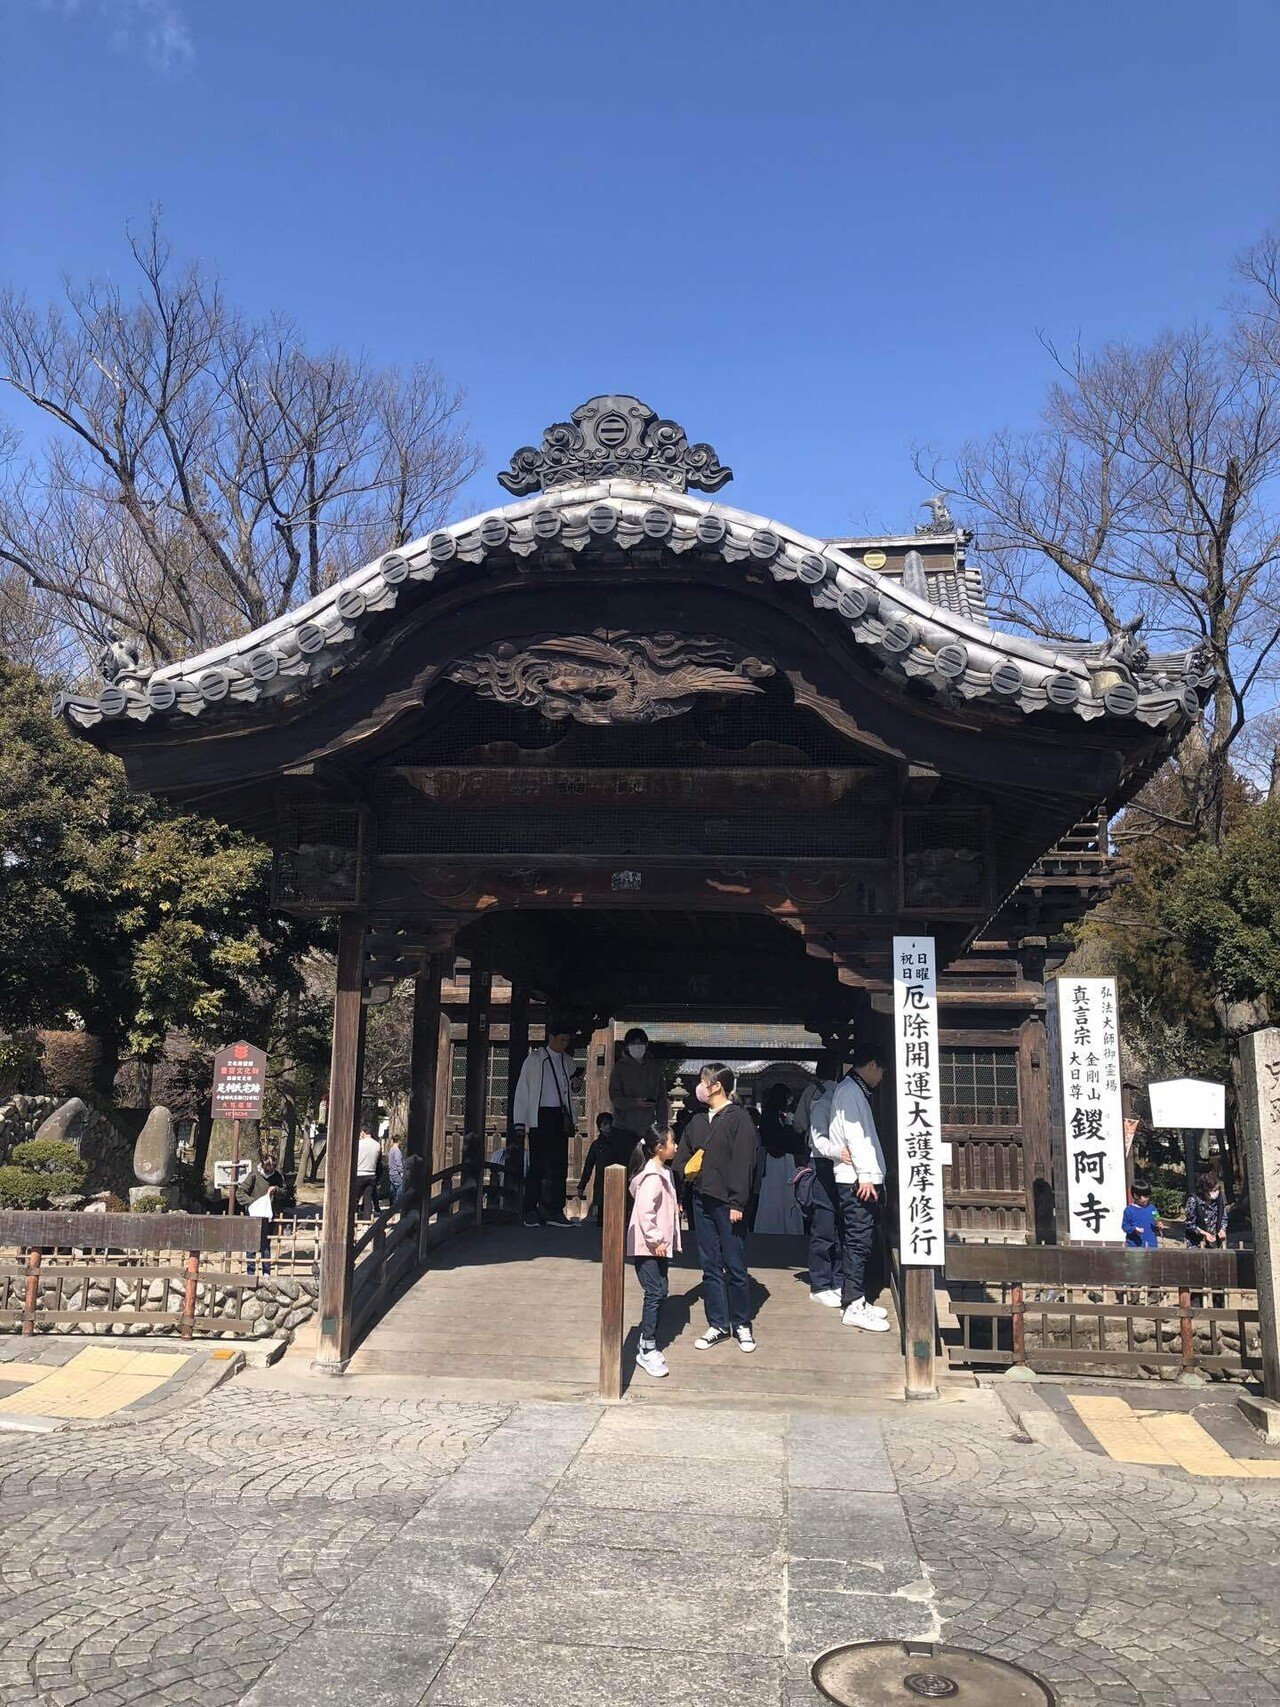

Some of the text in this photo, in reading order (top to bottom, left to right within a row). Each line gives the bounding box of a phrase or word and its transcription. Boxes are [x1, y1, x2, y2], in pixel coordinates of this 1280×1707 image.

[900, 952, 914, 979] 祝日
[915, 952, 930, 980] 日曜
[1071, 985, 1091, 1046] 真言宗
[1069, 1051, 1084, 1100] 大日尊
[1085, 1051, 1101, 1101] 金剛山
[903, 984, 938, 1257] 厄除開運大護摩修行
